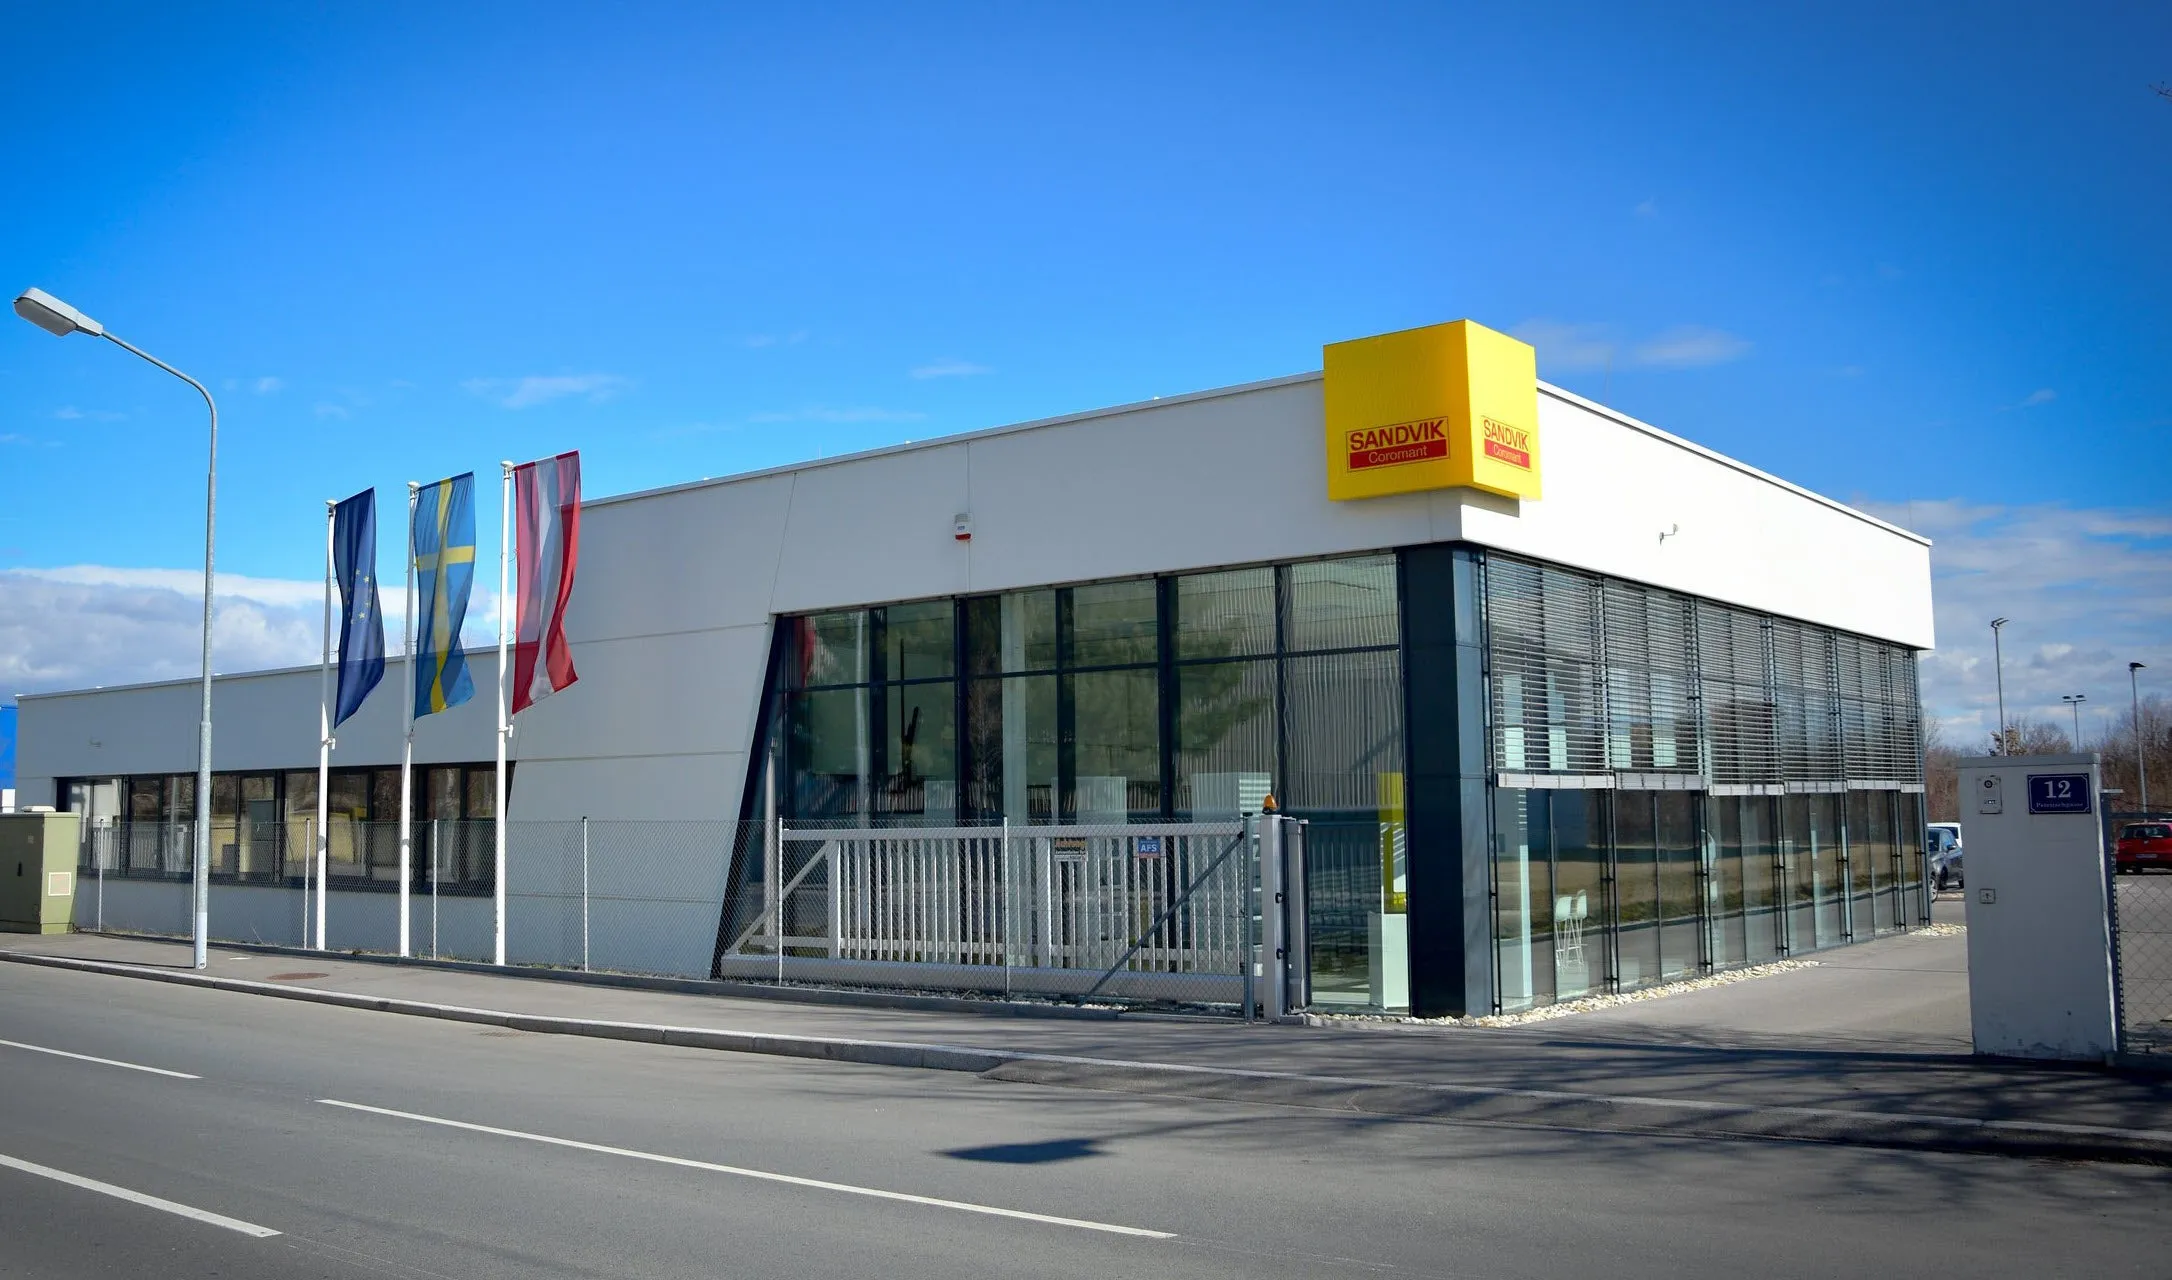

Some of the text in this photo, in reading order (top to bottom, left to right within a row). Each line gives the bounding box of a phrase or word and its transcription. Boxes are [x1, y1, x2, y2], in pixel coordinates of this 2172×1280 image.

[1350, 420, 1445, 451] SANDVIK
[1484, 419, 1529, 451] SANDVIK
[1368, 445, 1427, 464] Coromant
[1493, 444, 1522, 463] Coromant
[2044, 780, 2072, 799] 12
[1140, 844, 1158, 852] AFS
